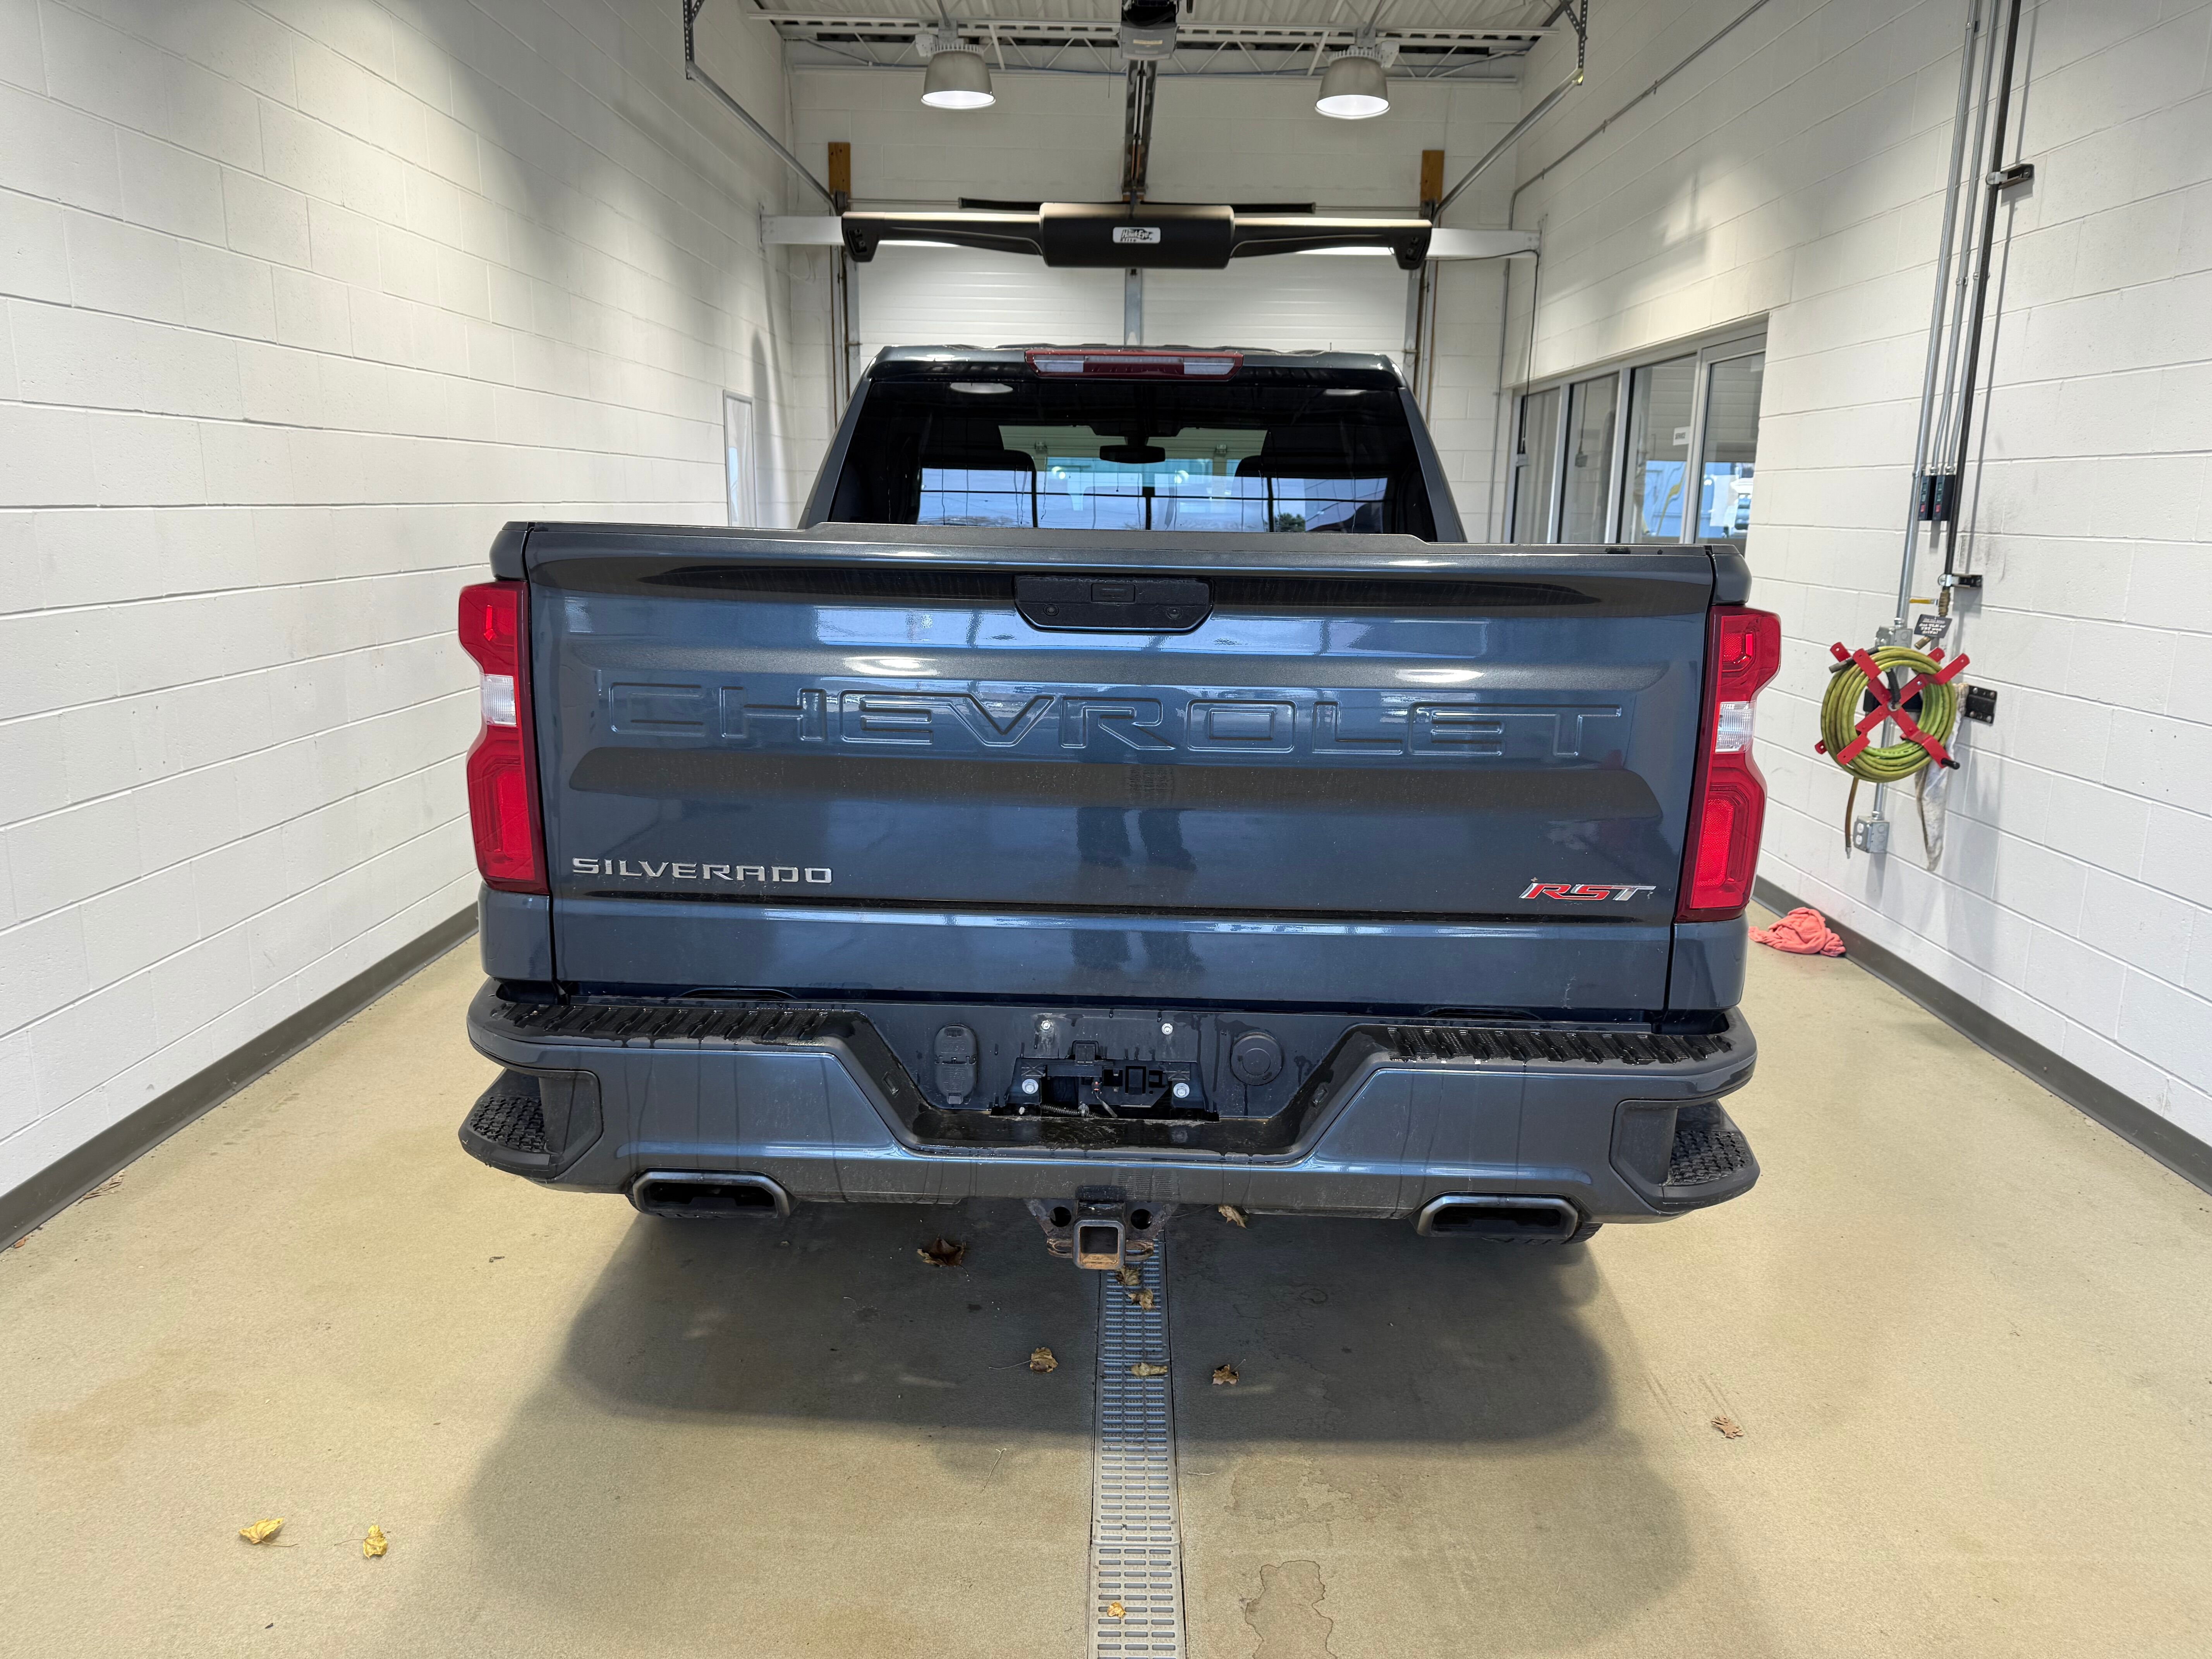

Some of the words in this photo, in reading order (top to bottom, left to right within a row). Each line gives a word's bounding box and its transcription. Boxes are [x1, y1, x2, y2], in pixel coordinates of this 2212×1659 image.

[608, 682, 1623, 757] CHEVROLET
[572, 857, 833, 884] SILVERADO
[1518, 883, 1657, 901] RST
